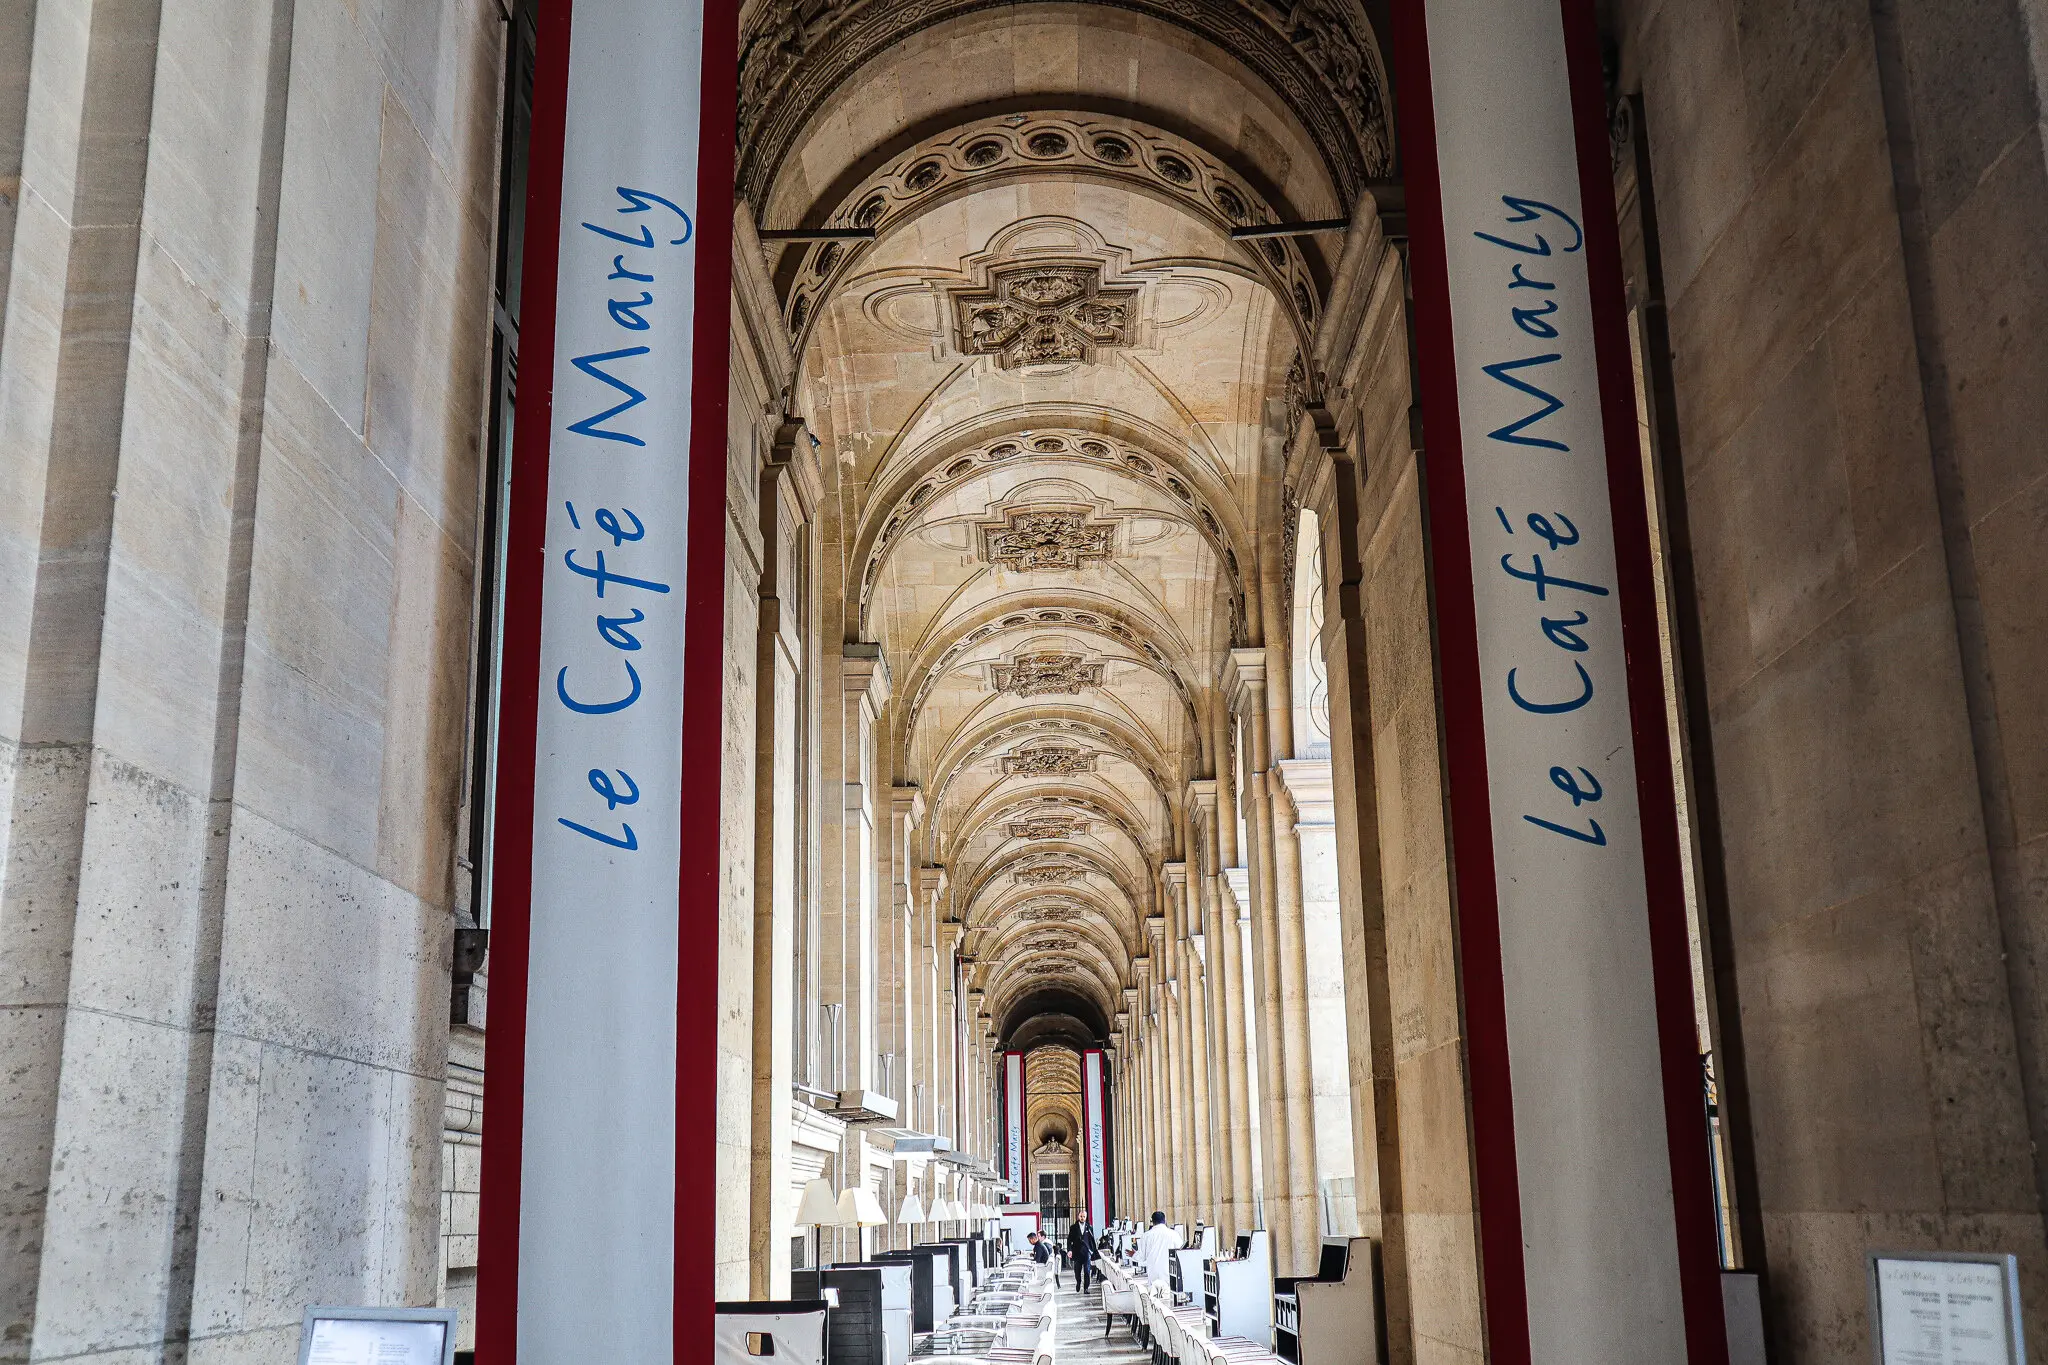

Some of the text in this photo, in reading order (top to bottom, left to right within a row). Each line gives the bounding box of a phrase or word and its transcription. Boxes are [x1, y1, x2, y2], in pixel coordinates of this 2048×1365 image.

[556, 186, 693, 851] Le Café Marly
[1473, 195, 1609, 848] Le Café Marly
